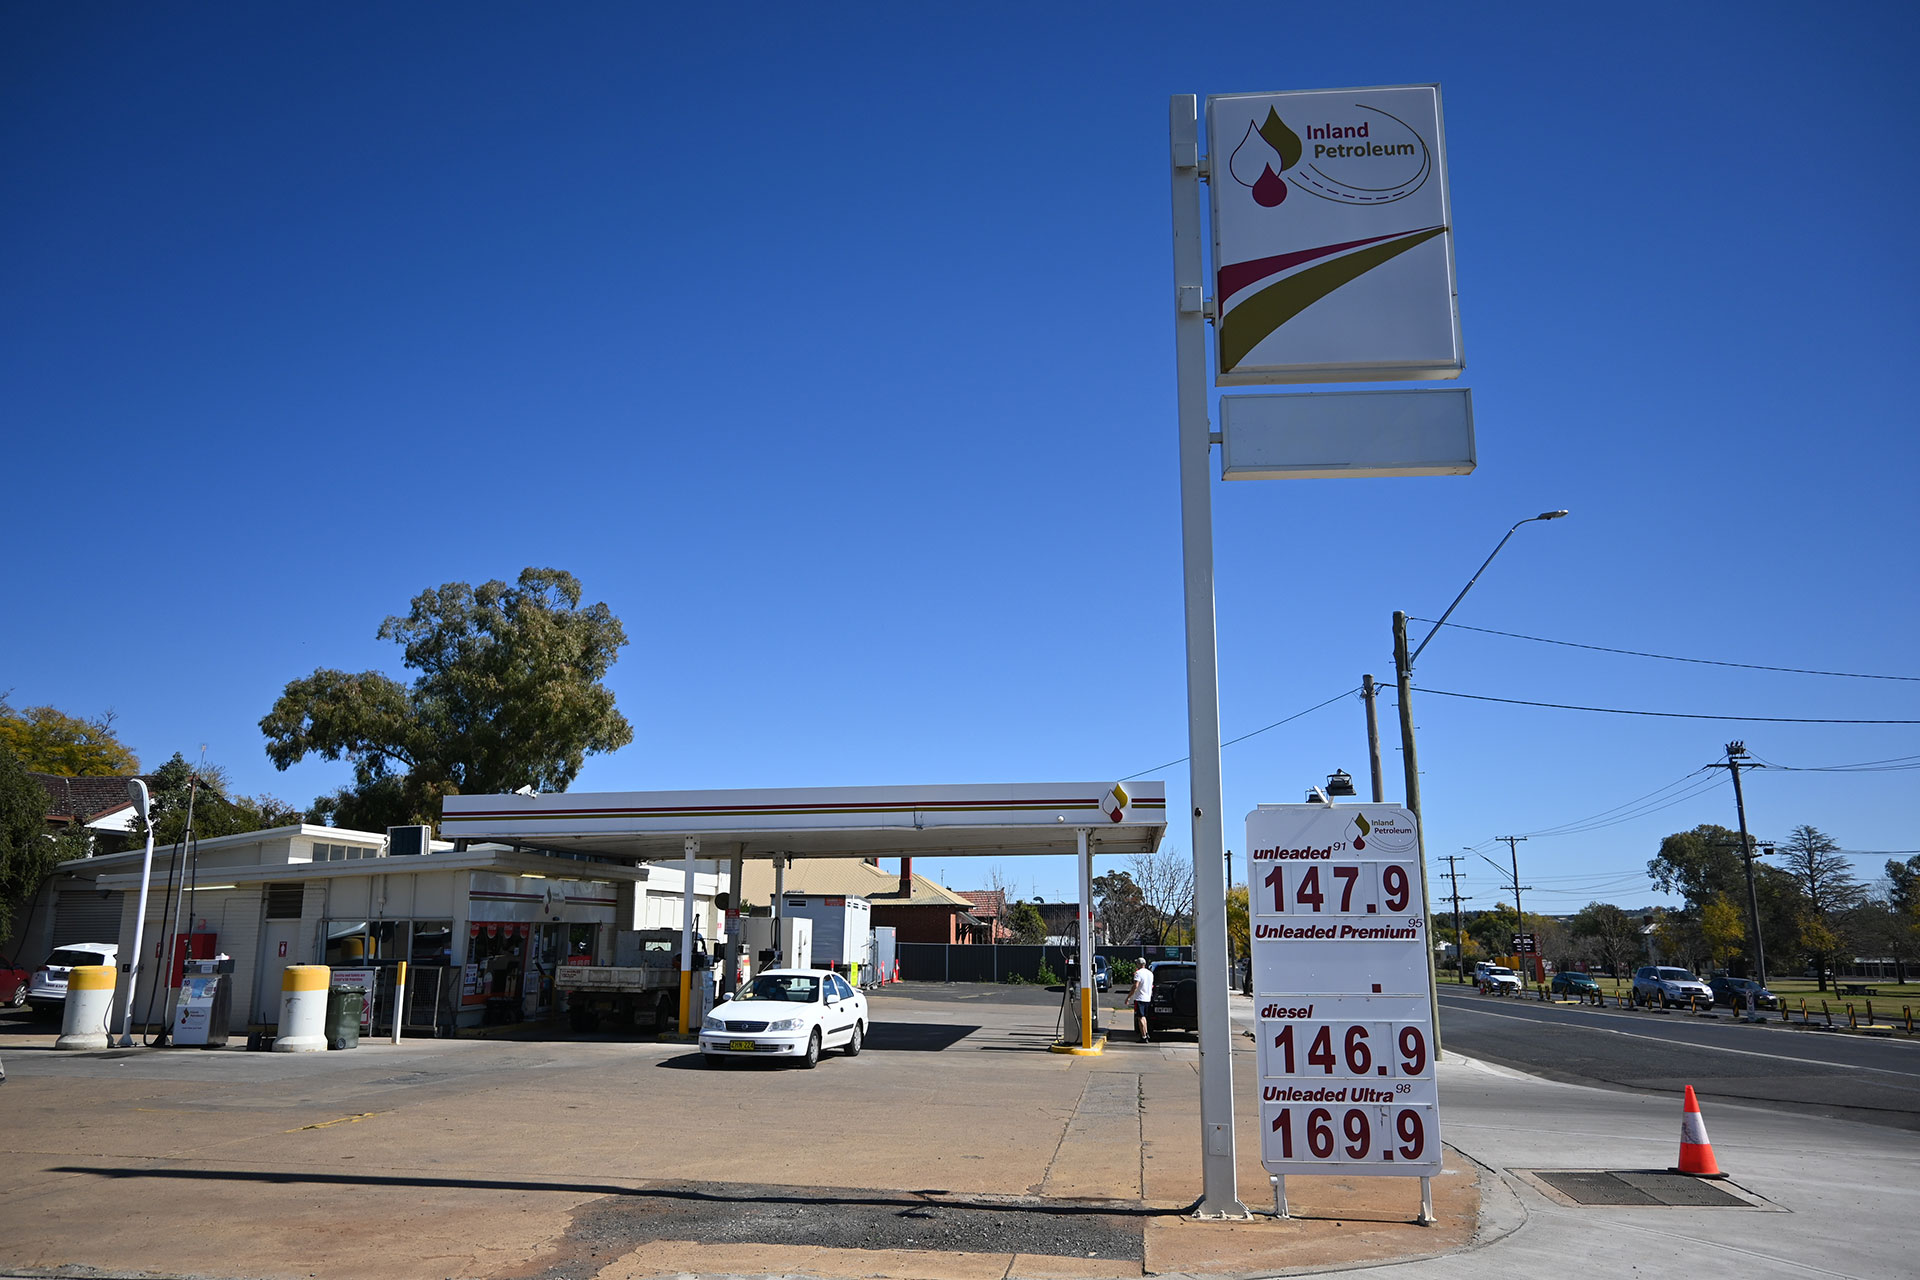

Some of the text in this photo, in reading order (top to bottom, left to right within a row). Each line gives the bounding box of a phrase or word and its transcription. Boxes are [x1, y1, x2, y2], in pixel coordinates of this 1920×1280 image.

[1306, 122, 1369, 140] Inland
[1314, 141, 1415, 158] Petroleum
[1371, 819, 1394, 827] Inland
[1374, 827, 1412, 835] Petroleum
[1253, 842, 1347, 860] unleaded 91
[1264, 865, 1410, 914] 147.9
[1255, 918, 1423, 939] Unleaded Premium 95
[1261, 1004, 1314, 1019] diesel
[1274, 1025, 1426, 1076] 146.9
[1262, 1084, 1412, 1103] Unleaded Ultra 98
[1272, 1108, 1425, 1161] 169.9
